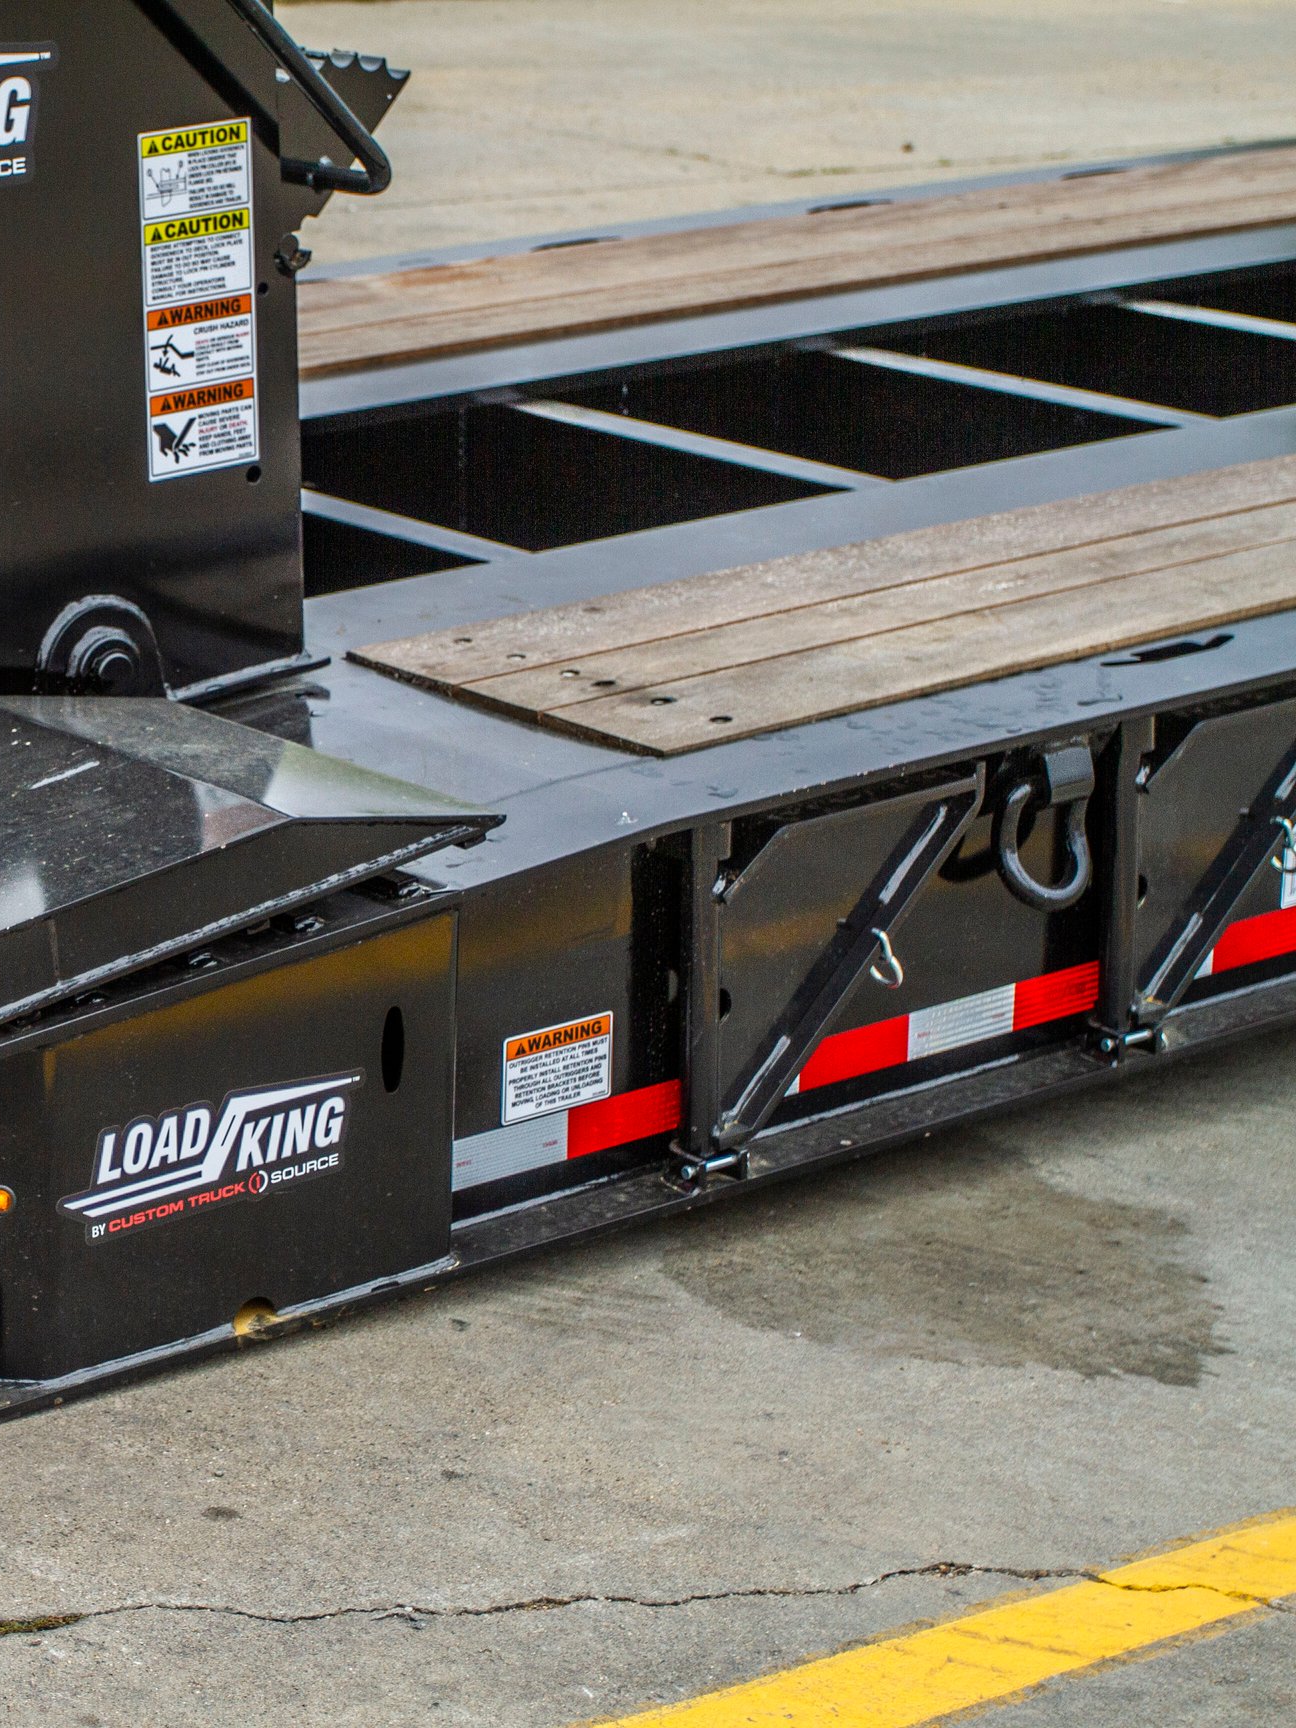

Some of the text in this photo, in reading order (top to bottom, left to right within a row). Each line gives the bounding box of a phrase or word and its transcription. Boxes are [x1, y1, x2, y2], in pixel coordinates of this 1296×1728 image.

[162, 126, 240, 150] CAUTION
[165, 212, 243, 238] CAUTION
[174, 239, 205, 248] ATTEMPTING
[210, 261, 235, 269] CYLINDER
[170, 299, 241, 323] WARNING
[194, 319, 248, 335] CRUSH HAZARD
[173, 383, 244, 408] WARNING
[198, 411, 219, 419] MOVING
[211, 438, 236, 446] CLOTHING
[528, 1020, 602, 1052] WARNING
[509, 1055, 542, 1068] OUTRIGGER
[545, 1046, 576, 1058] RETENTION
[530, 1058, 560, 1070] INSTALLED
[582, 1048, 598, 1056] TIMES
[509, 1073, 537, 1085] PROPERLY
[540, 1067, 561, 1076] INSTALL
[563, 1058, 592, 1070] RETENTION
[514, 1080, 540, 1091] THROUGH
[554, 1066, 589, 1080] OUTRIGGERS
[515, 1070, 600, 1098] RETENTION BRACKETS BEFORE
[536, 1090, 560, 1100] LOADING
[571, 1077, 603, 1090] UNLOADING
[558, 1091, 580, 1101] TRAILER
[97, 1096, 345, 1185] LOAD KING
[91, 1223, 106, 1238] BY
[108, 1200, 184, 1233] CUSTOM
[187, 1180, 246, 1208] TRUCK
[270, 1152, 340, 1184] SOURCE
